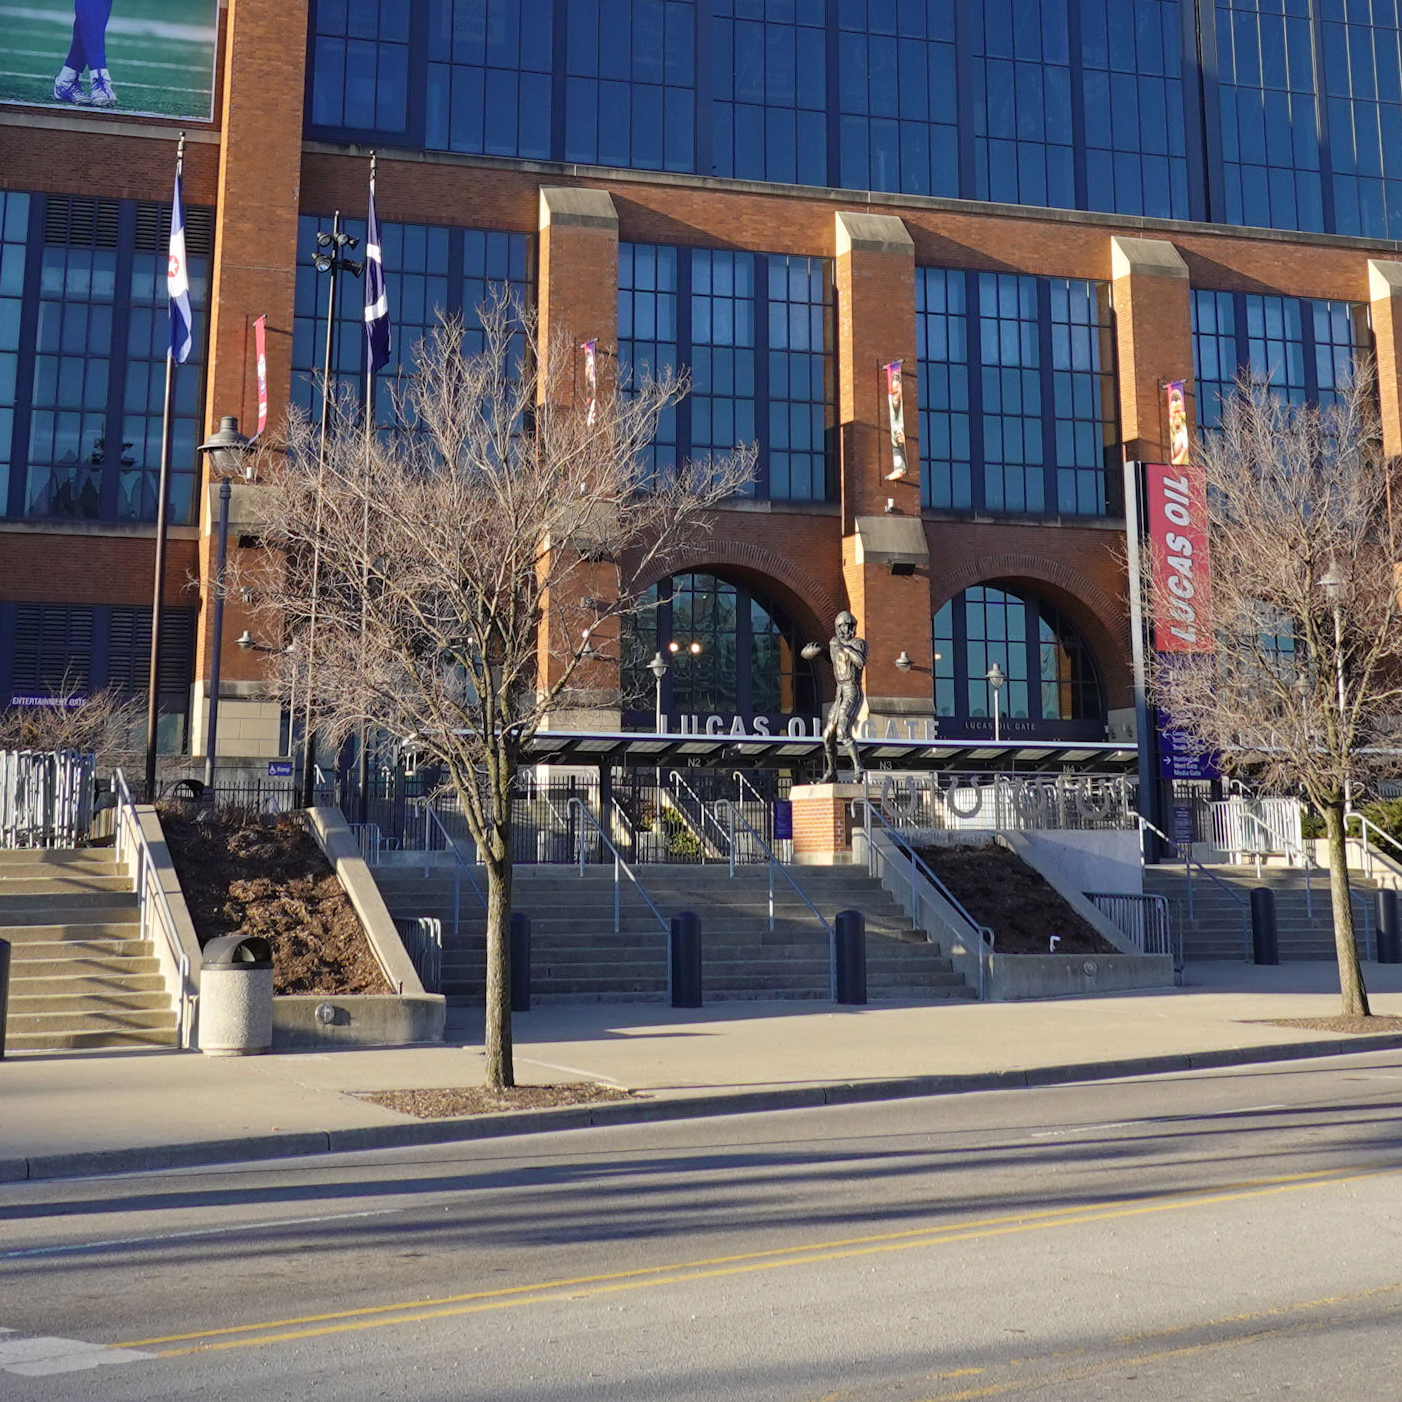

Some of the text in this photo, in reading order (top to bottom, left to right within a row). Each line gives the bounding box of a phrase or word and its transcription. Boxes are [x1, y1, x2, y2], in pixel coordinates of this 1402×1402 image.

[1163, 475, 1197, 644] LUCAS OIL
[660, 714, 940, 740] LUCAS OI GATE
[965, 721, 994, 730] LUCAS
[1015, 723, 1036, 731] GATE
[687, 758, 701, 767] N2
[879, 760, 893, 770] N3
[1063, 764, 1075, 773] N4
